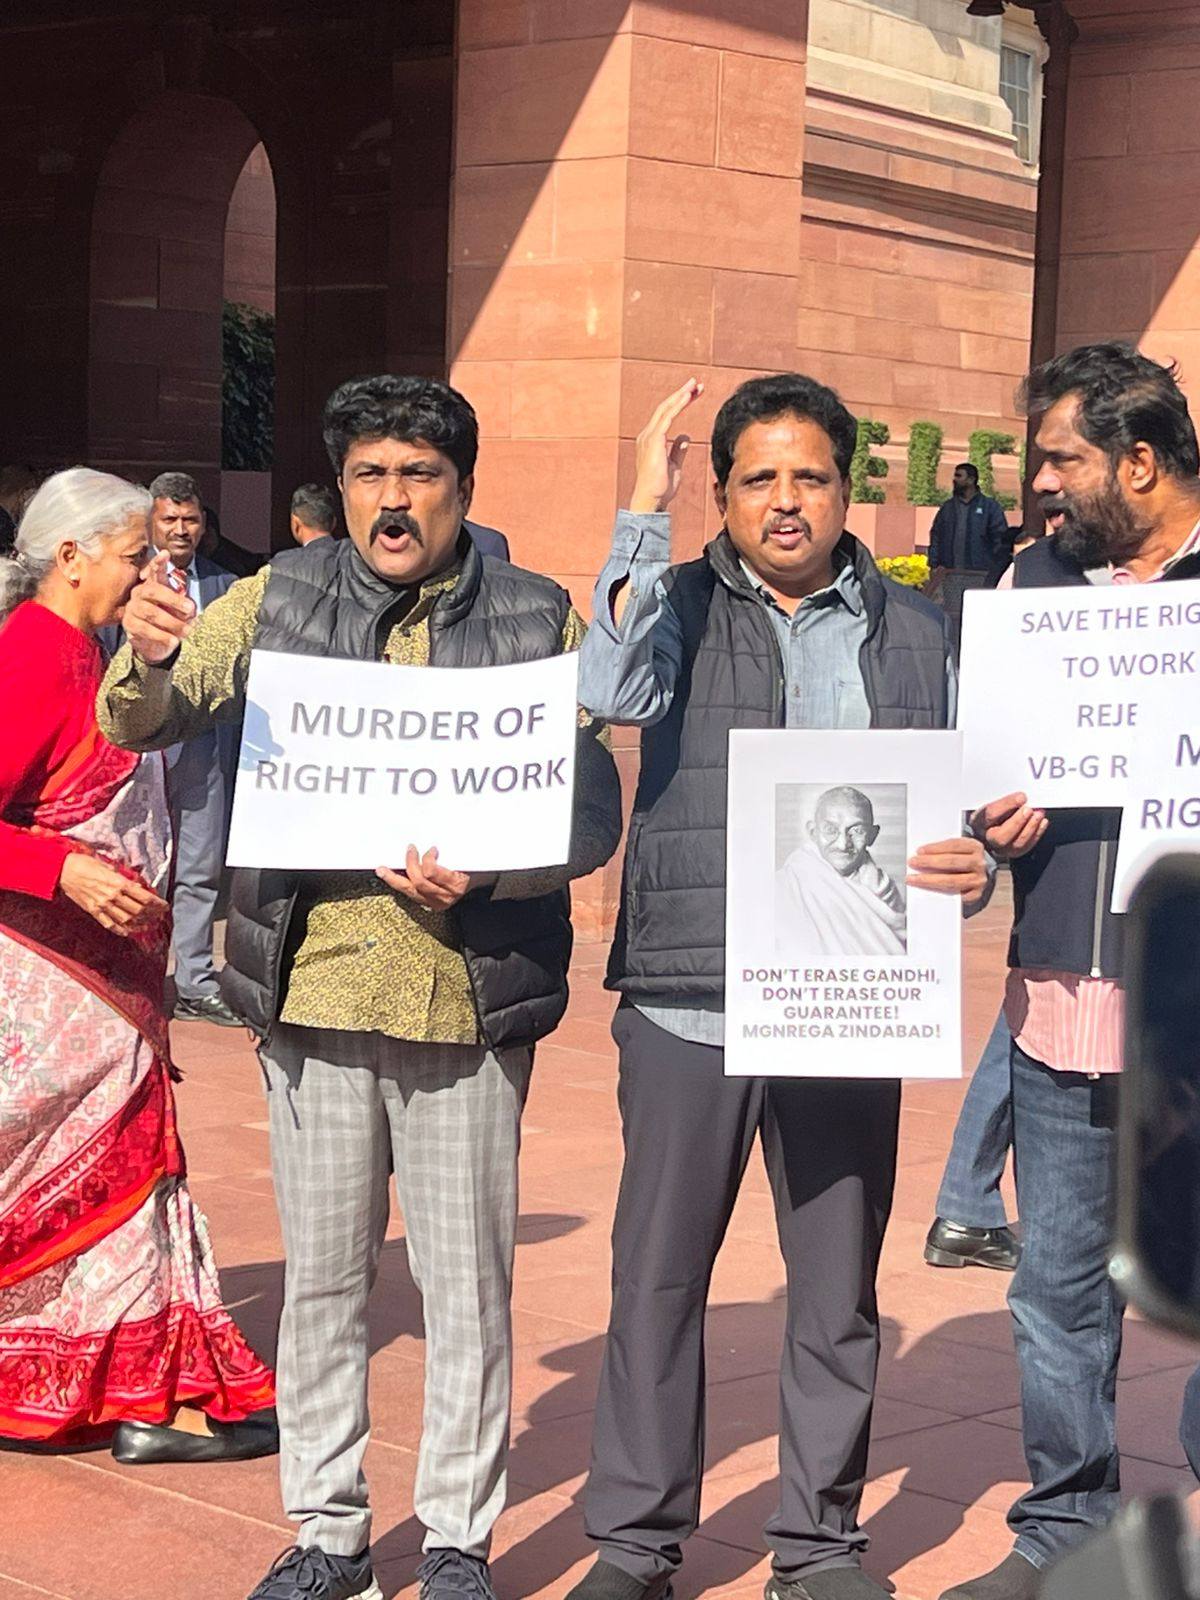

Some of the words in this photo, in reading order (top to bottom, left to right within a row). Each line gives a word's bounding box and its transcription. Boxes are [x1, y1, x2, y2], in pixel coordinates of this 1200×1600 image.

[1021, 610, 1089, 634] SAVE
[1098, 606, 1149, 630] THE
[1063, 656, 1099, 678] TO
[1109, 651, 1195, 677] WORK
[291, 702, 479, 741] MURDER
[494, 703, 545, 738] OF
[255, 759, 376, 795] RIGHT
[386, 767, 438, 796] TO
[452, 757, 567, 794] WORK
[1028, 754, 1100, 780] VB-G
[742, 968, 799, 983] DON’T
[804, 969, 859, 983] ERASE
[864, 968, 941, 985] GANDHI,
[762, 987, 819, 1001] DON’T
[824, 987, 879, 1001] ERASE
[883, 987, 922, 1001] OUR
[784, 1005, 900, 1020] GUARANTEE!
[742, 1024, 834, 1039] MGNREGA
[839, 1024, 941, 1039] ZINDABAD!
